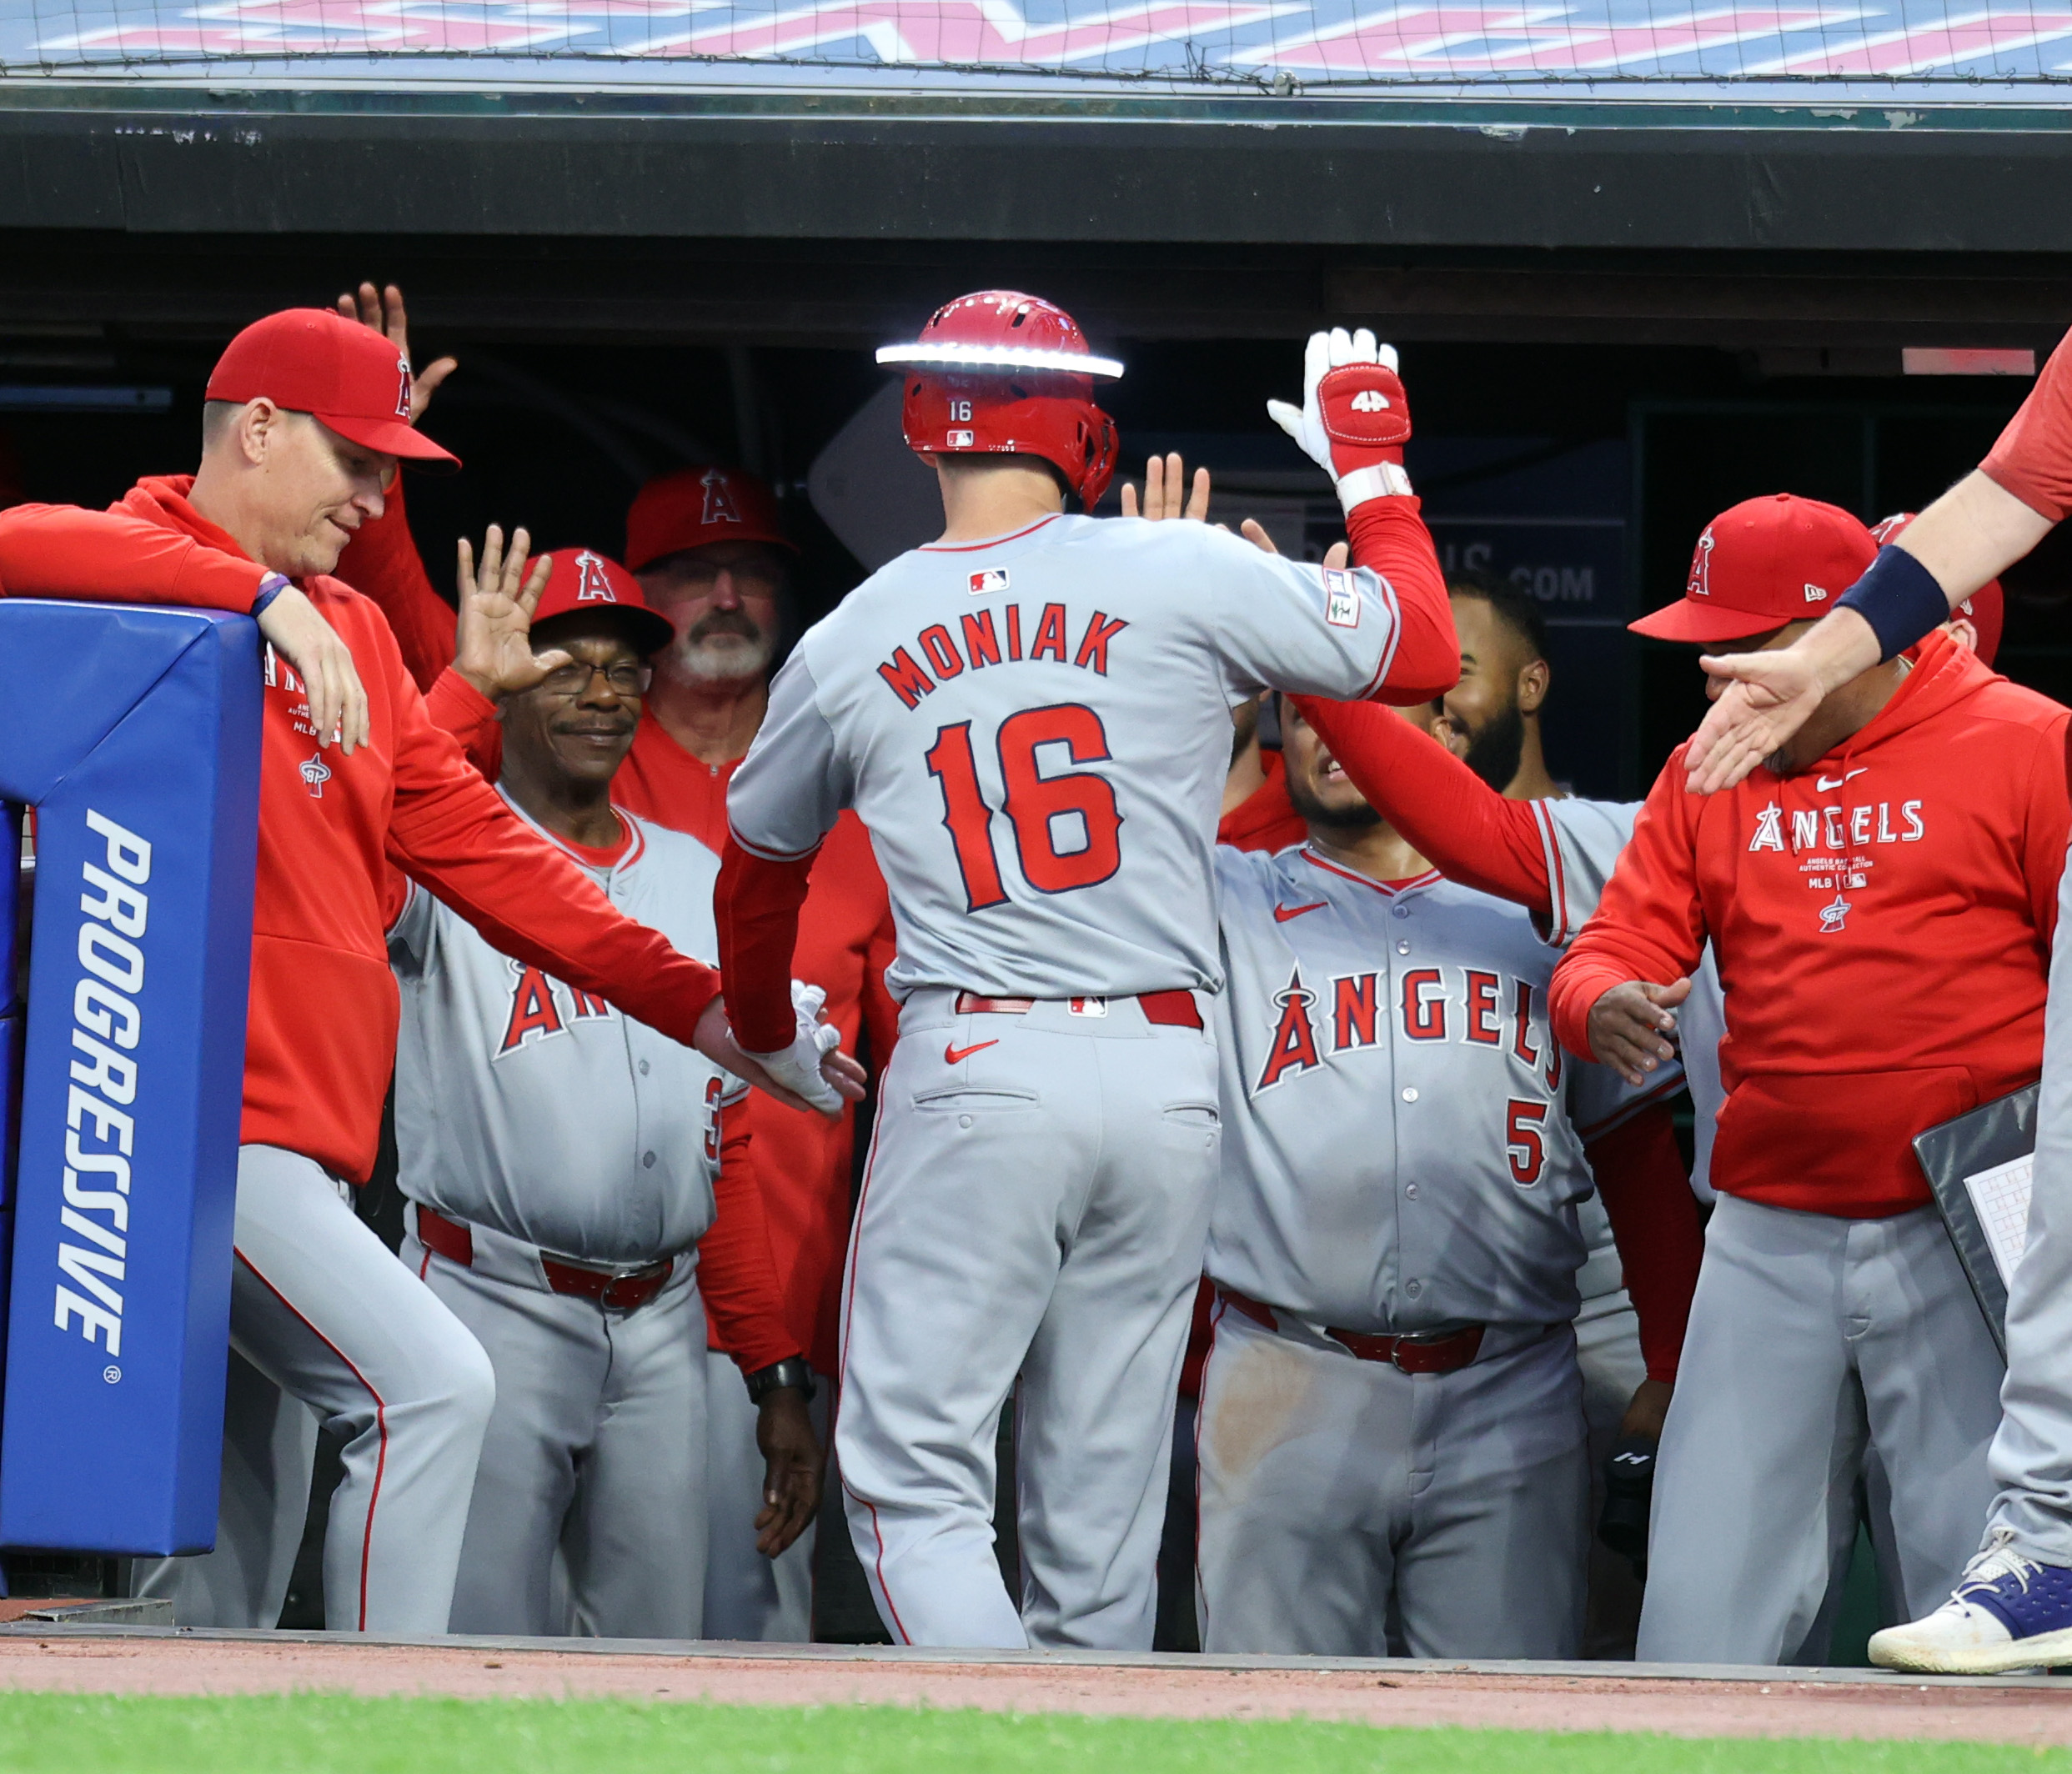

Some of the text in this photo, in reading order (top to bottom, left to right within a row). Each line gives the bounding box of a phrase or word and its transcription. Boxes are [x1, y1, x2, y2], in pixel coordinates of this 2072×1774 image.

[950, 400, 972, 423] 16
[700, 468, 742, 525] A
[574, 549, 617, 602] A
[1687, 526, 1715, 596] A
[876, 602, 1130, 712] MONIAK
[924, 702, 1126, 915] 16
[1748, 799, 1925, 852] ANGELS
[1809, 877, 1833, 890] MLB
[53, 808, 152, 1357] PROGRESSIVE
[1506, 1096, 1550, 1189] 5
